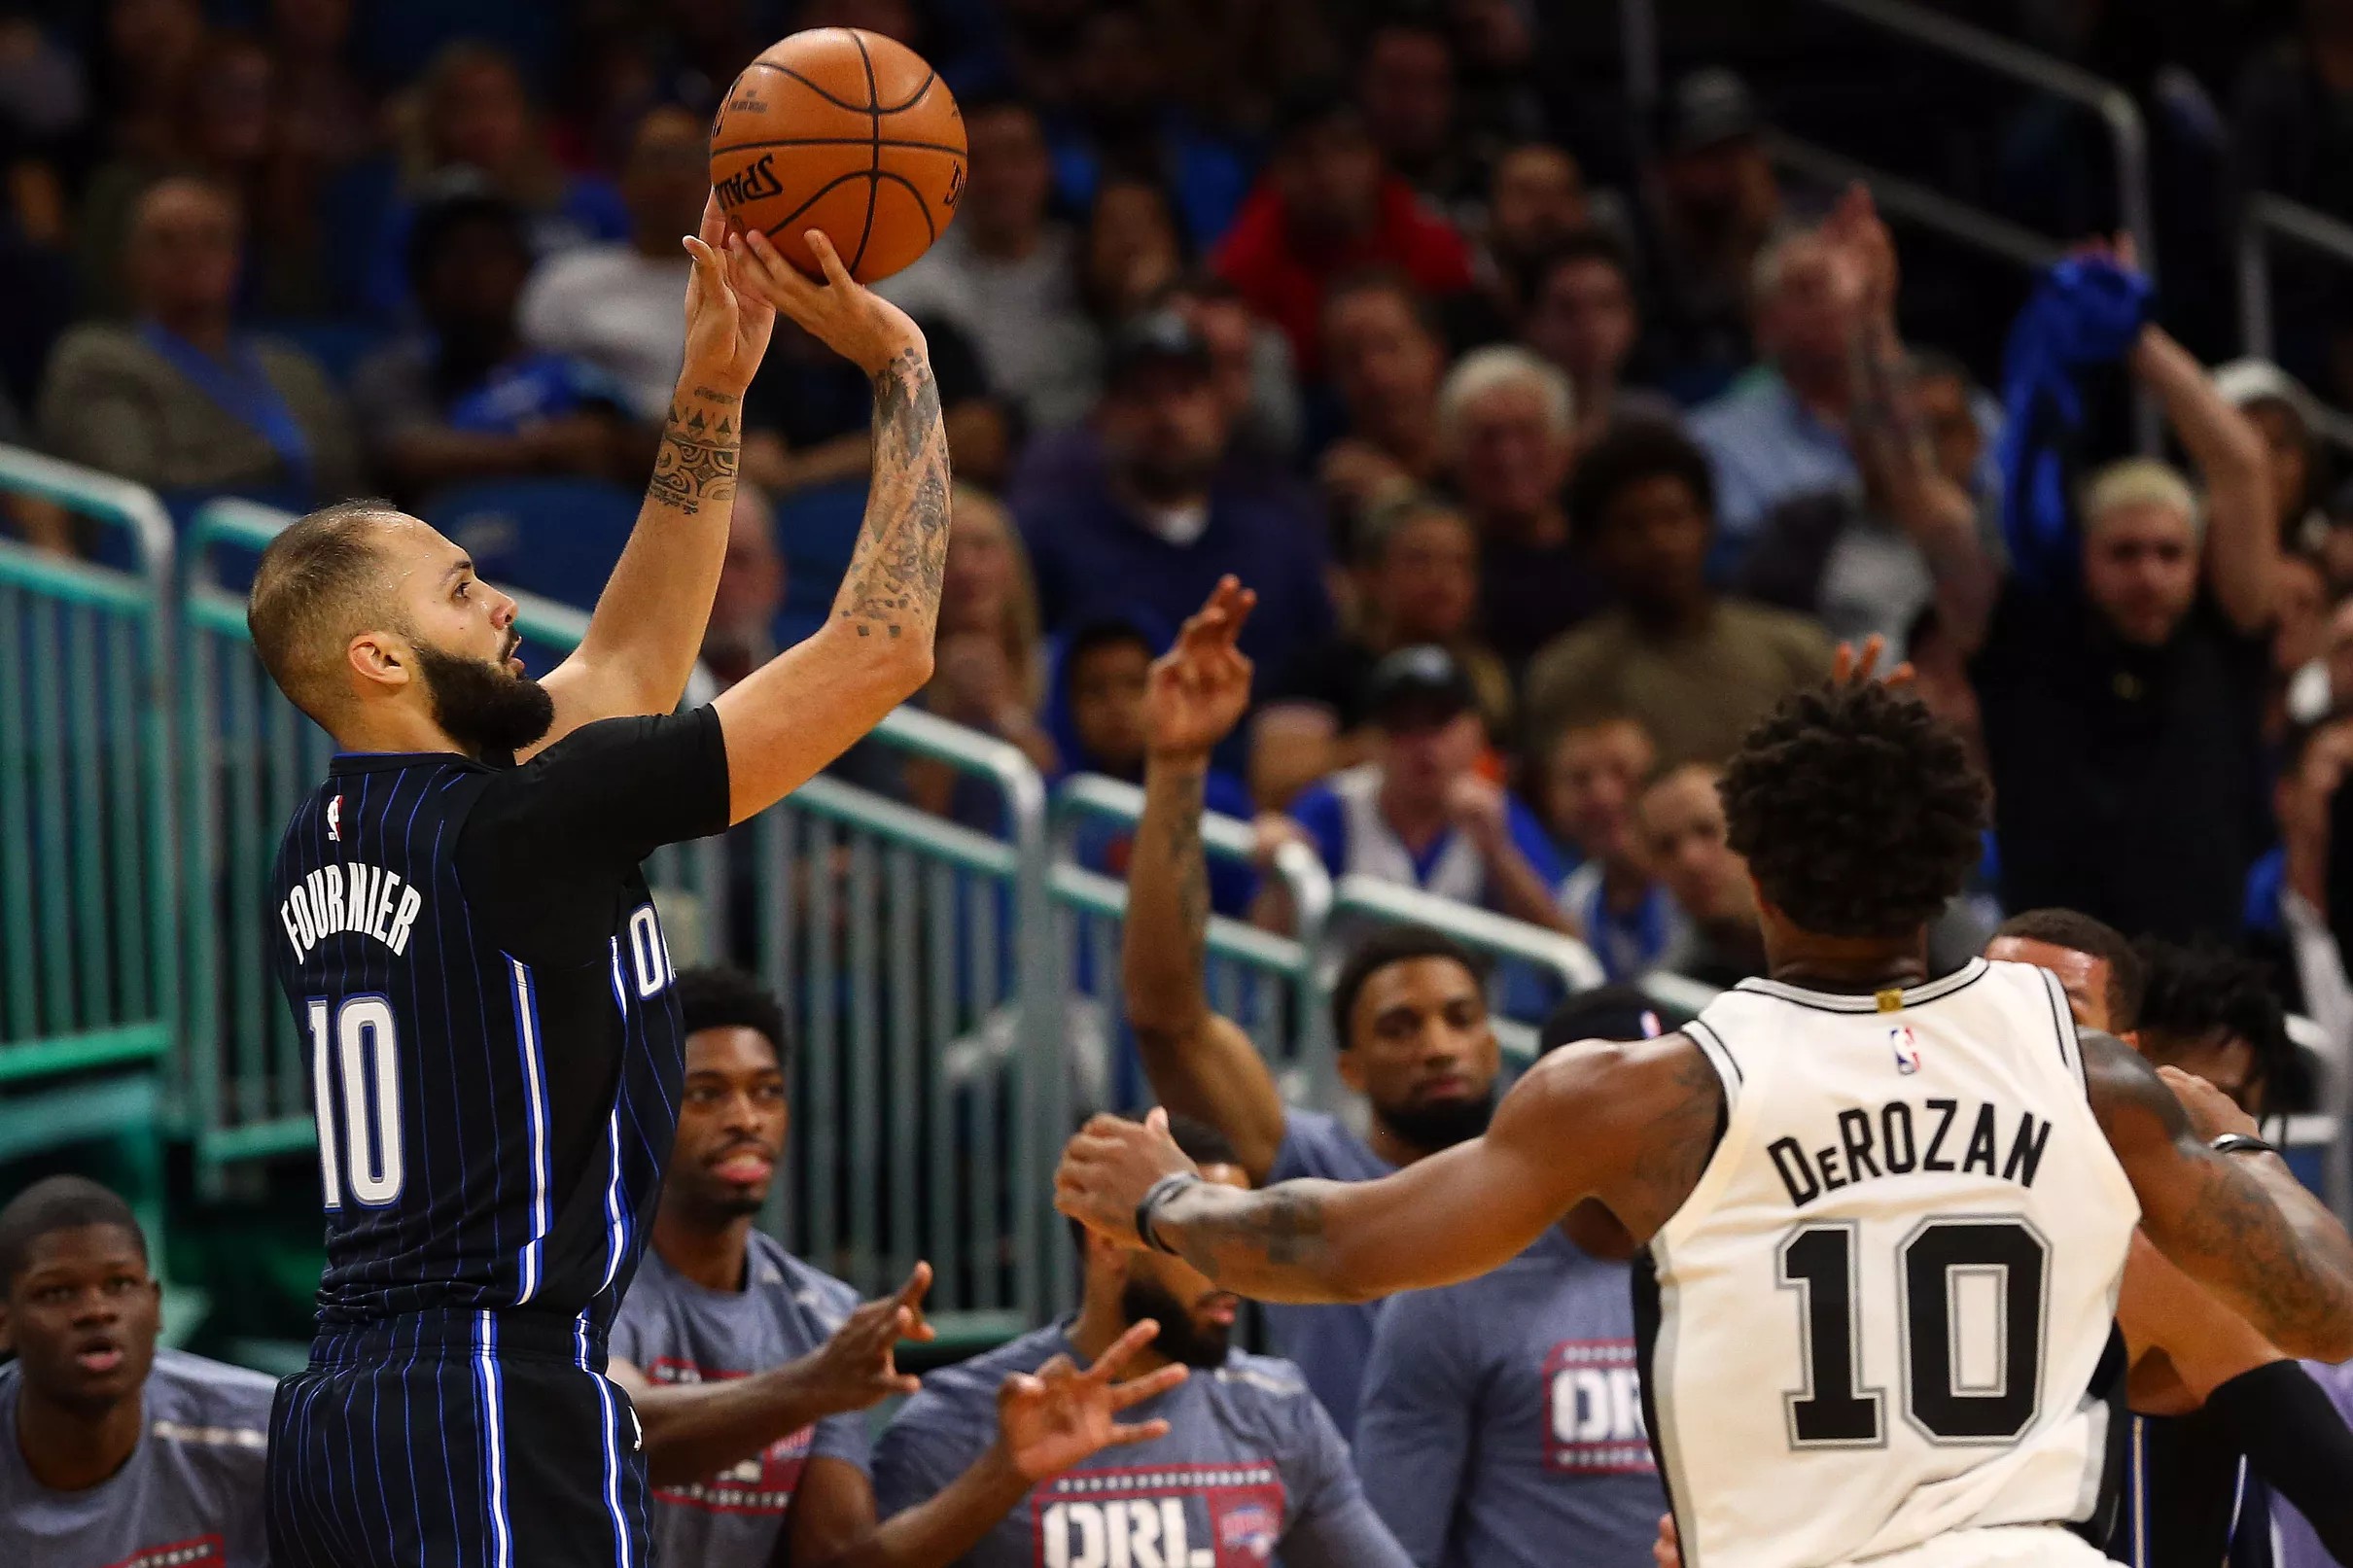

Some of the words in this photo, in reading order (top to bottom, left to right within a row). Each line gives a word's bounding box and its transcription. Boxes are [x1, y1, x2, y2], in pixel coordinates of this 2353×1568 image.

[280, 861, 422, 965] FOURNIER
[306, 992, 406, 1212] 10
[1767, 1098, 2053, 1207] DeROZAN
[1775, 1214, 2053, 1450] 10
